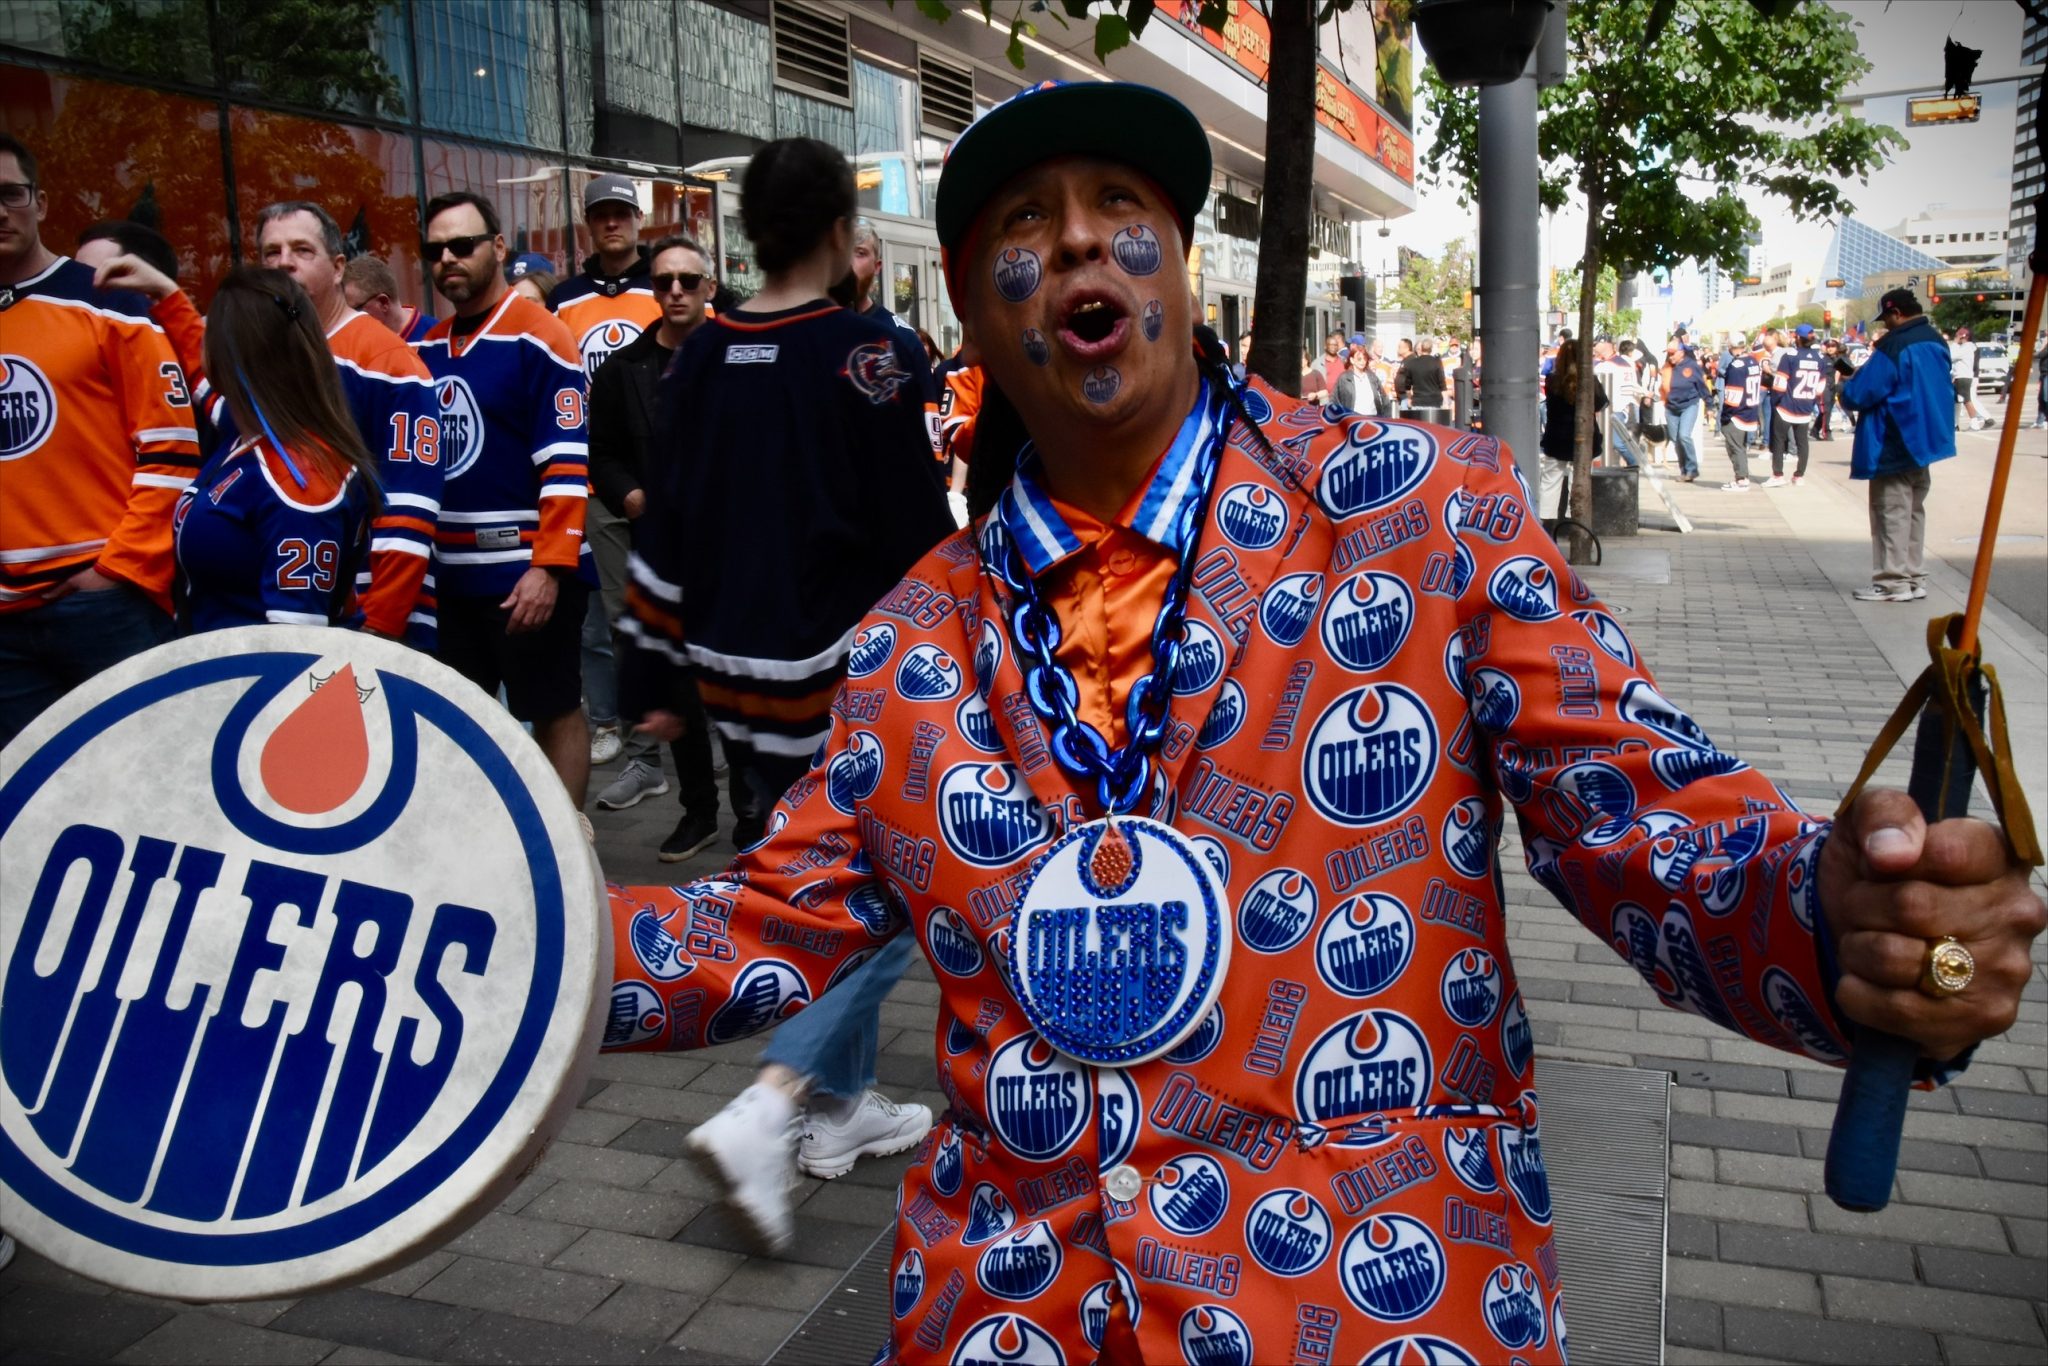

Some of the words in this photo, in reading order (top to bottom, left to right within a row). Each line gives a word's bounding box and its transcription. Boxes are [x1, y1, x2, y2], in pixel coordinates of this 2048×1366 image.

[998, 259, 1037, 297] OILERS
[1118, 239, 1159, 270] OILERS
[726, 345, 779, 363] CCM
[1793, 371, 1820, 399] 29
[389, 412, 440, 465] 18
[1328, 438, 1420, 510] OILERS
[1224, 499, 1281, 545] OILERS
[1332, 500, 1431, 573] OILERS
[277, 537, 340, 591] 29
[1191, 547, 1259, 645] OILE
[1332, 597, 1403, 661] OILERS
[901, 653, 952, 697] OILERS
[1260, 659, 1316, 751] OILERS
[903, 720, 947, 803] OILERS
[1003, 691, 1052, 777] OILERS
[1319, 728, 1421, 812] OILERS
[949, 791, 1043, 856] OILERS
[1181, 757, 1296, 854] OILERS
[859, 806, 938, 893] OILERS
[1325, 814, 1432, 895] OILERS
[761, 915, 845, 958] OILERS
[1246, 888, 1307, 945] OILERS
[1420, 878, 1487, 937] OILER
[934, 923, 978, 969] OILERS
[1028, 901, 1188, 1040] OILERS
[1327, 921, 1403, 986] OILERS
[2, 824, 497, 1205] OILERS
[1244, 979, 1309, 1077] OILERS
[996, 1071, 1077, 1145] OILERS
[1313, 1056, 1417, 1120] OILERS
[1149, 1071, 1294, 1174] OILERS
[1016, 1156, 1095, 1216] OILERS
[1330, 1135, 1440, 1216] OILERS
[1459, 1130, 1497, 1182] OILER
[1162, 1165, 1216, 1228] OILERS
[1445, 1196, 1512, 1252] OILER
[984, 1243, 1050, 1294] OILERS
[1136, 1236, 1242, 1298] OILERS
[1256, 1209, 1322, 1269] OILERS
[1351, 1241, 1435, 1312] OILERS
[1188, 1330, 1243, 1366] OILERS
[1296, 1303, 1340, 1366] ERS
